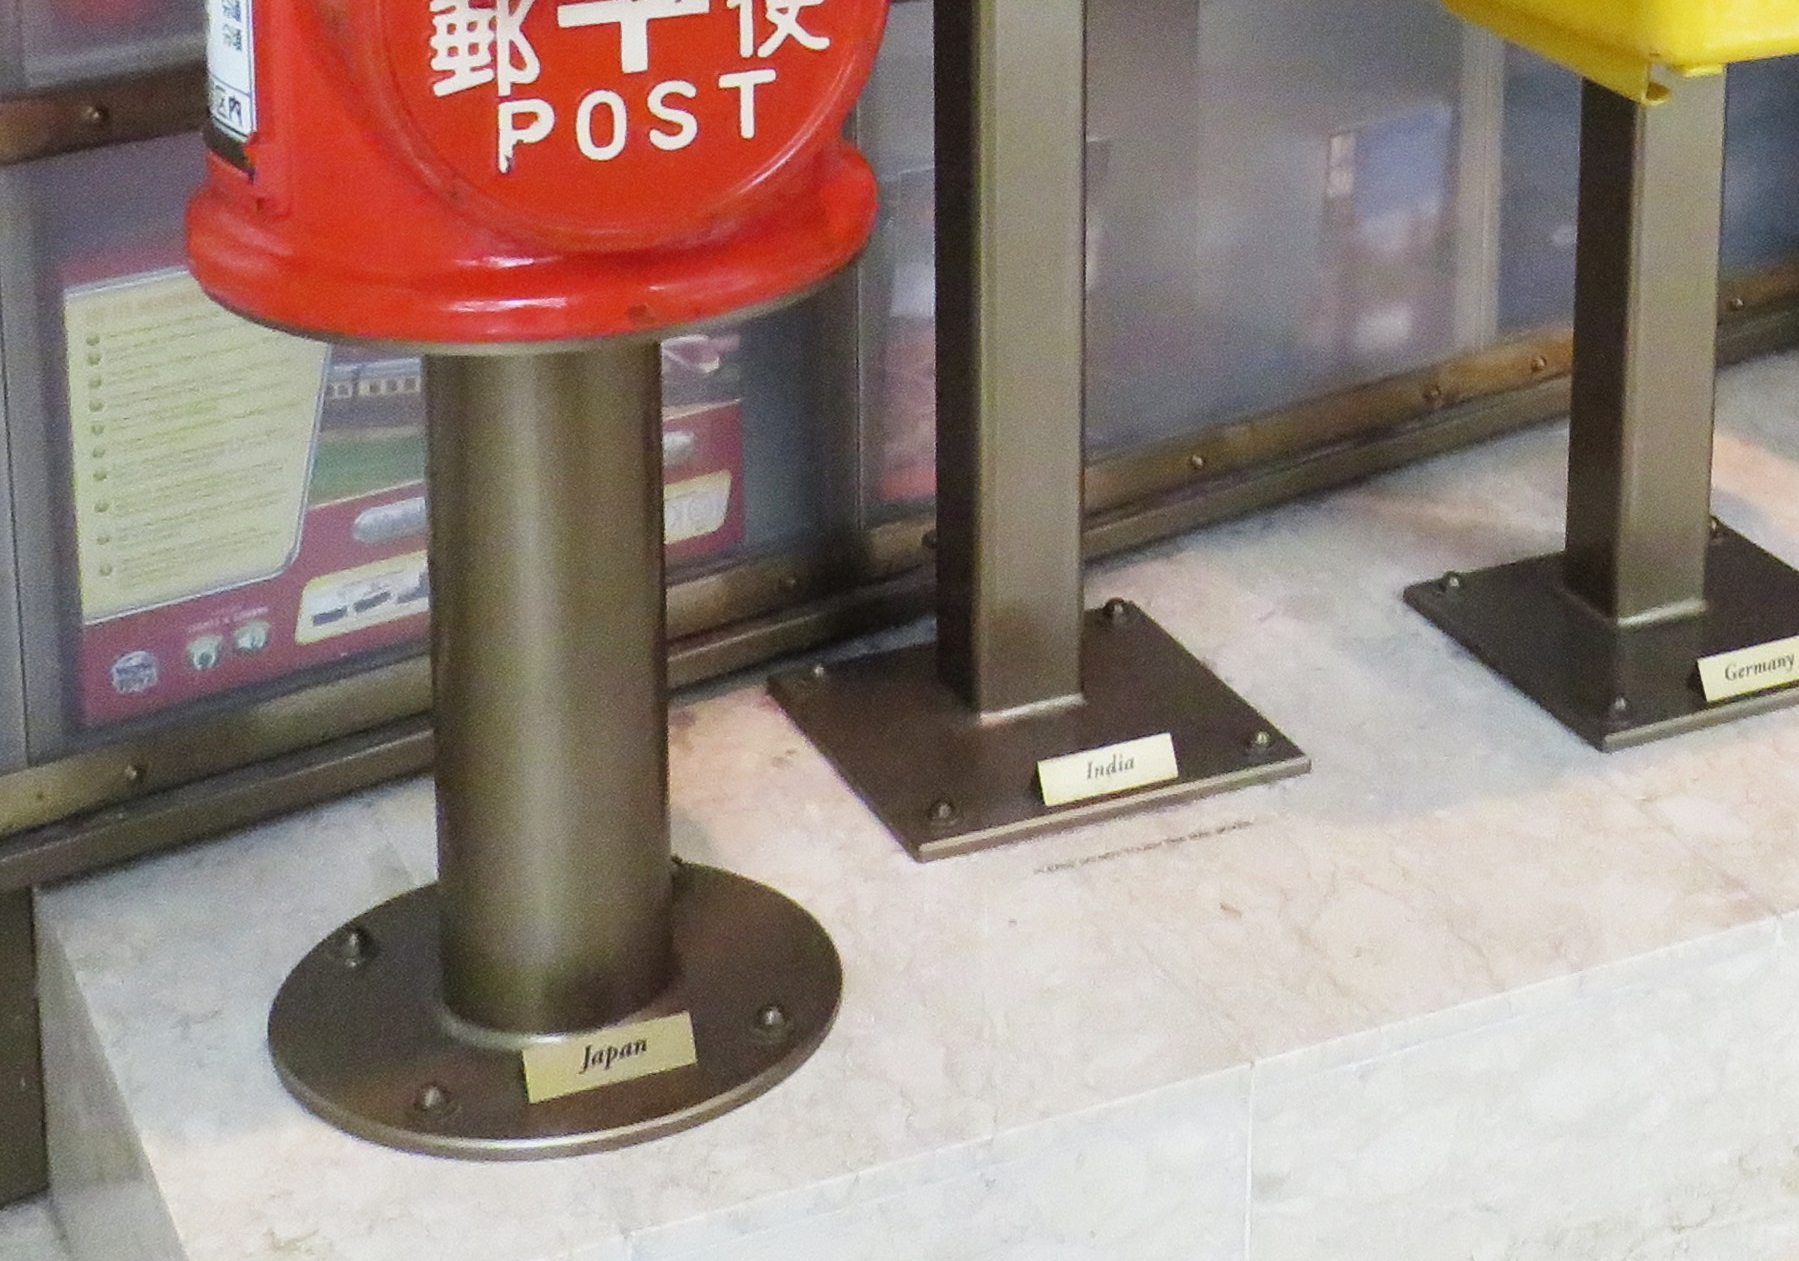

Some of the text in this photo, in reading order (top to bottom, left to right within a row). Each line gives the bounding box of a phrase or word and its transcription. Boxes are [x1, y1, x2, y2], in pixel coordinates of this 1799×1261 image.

[498, 68, 777, 173] POST
[1724, 653, 1795, 681] Germany
[1086, 754, 1135, 780] India
[578, 1038, 649, 1074] Japan
